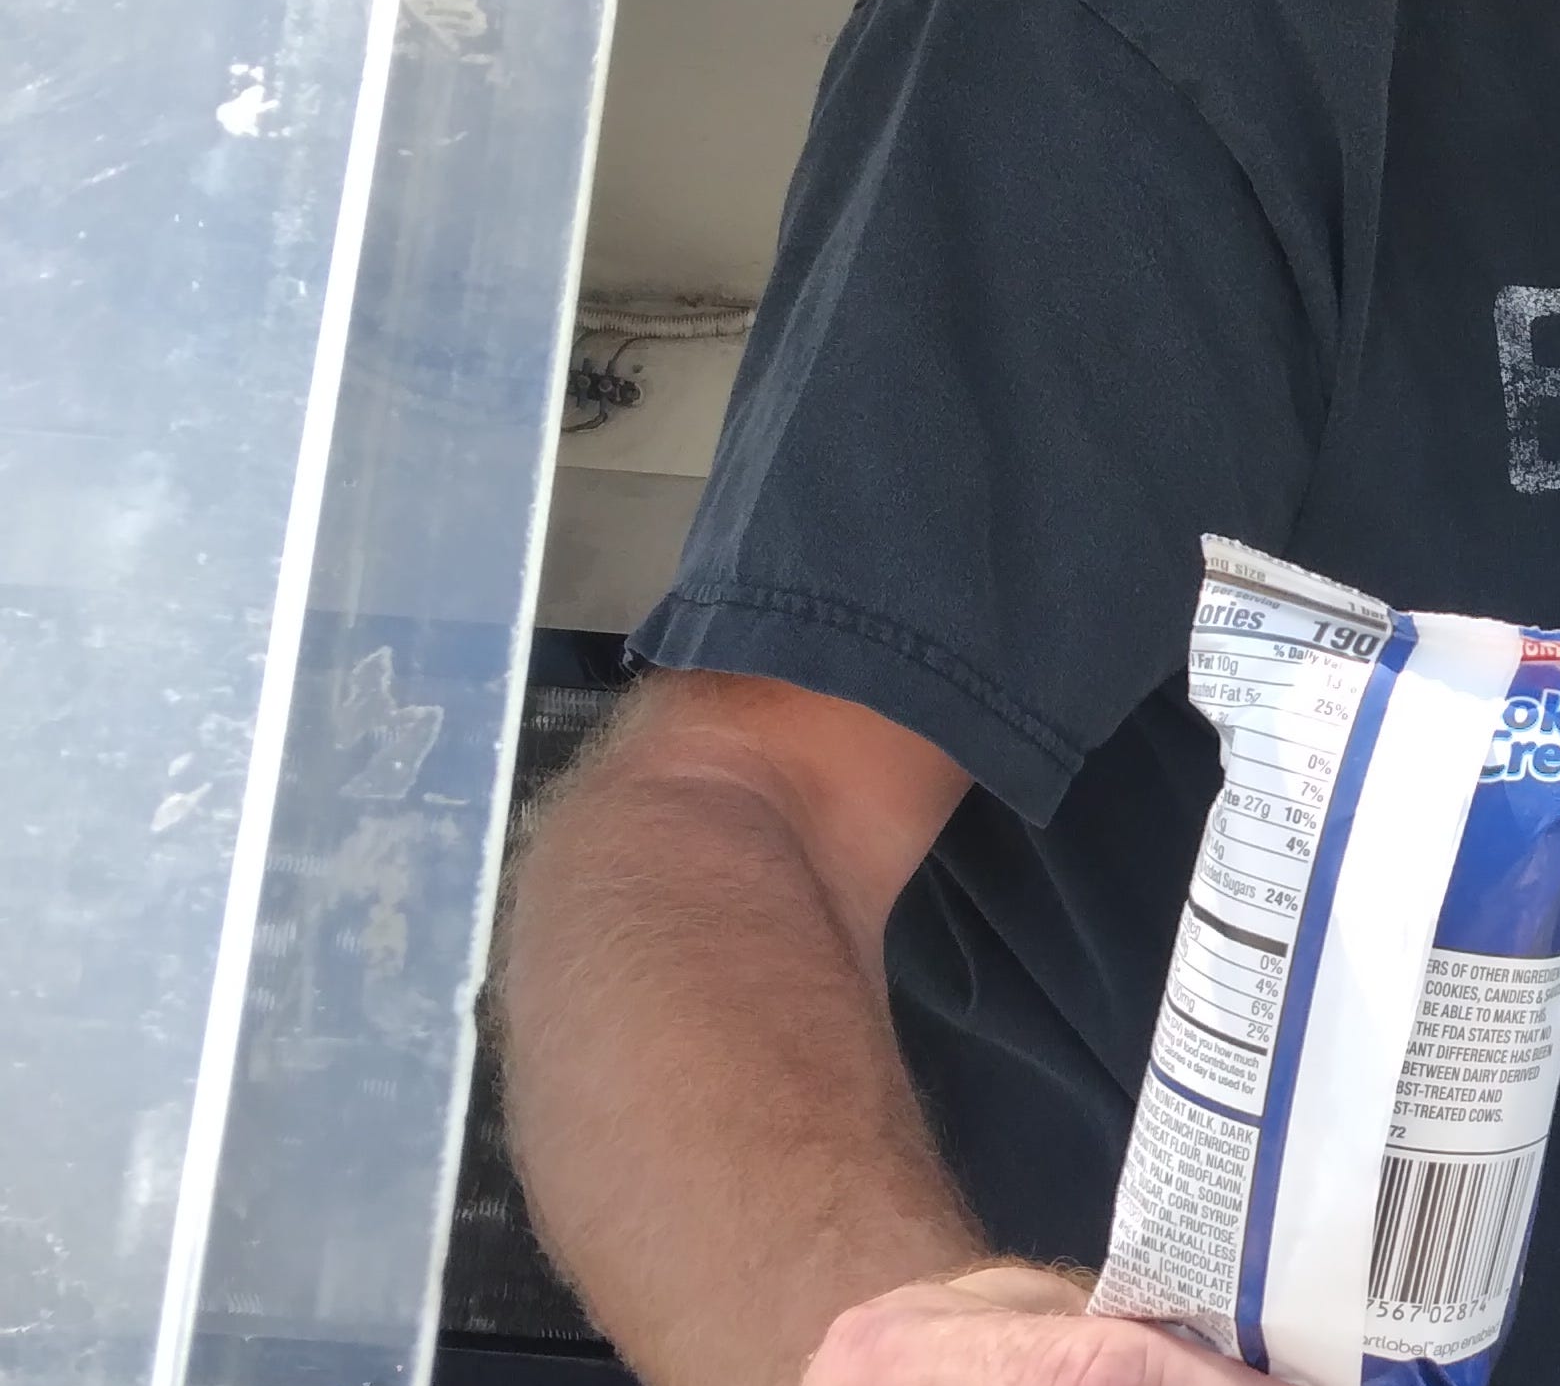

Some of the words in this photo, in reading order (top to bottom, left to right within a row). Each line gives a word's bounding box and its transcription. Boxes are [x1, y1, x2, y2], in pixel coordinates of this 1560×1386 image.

[1312, 619, 1381, 657] 190
[1197, 652, 1215, 670] Fat
[1216, 654, 1240, 676] 10g
[1288, 645, 1320, 664] Daily
[1219, 683, 1242, 703] Fat
[1313, 698, 1349, 721] 25%
[1307, 753, 1332, 775] 0%
[1300, 780, 1324, 803] 7%
[1243, 793, 1272, 819] 27g
[1283, 805, 1317, 830] 10%
[1285, 836, 1311, 857] 4%
[1221, 871, 1257, 899] Sugars
[1264, 887, 1299, 912] 24%
[1259, 954, 1284, 975] 0%
[1450, 962, 1469, 979] OF
[1469, 964, 1510, 983] OTHER
[1254, 977, 1279, 998] 4%
[1424, 979, 1481, 1004] COOKIES,
[1483, 987, 1535, 1005] CANDIES
[1250, 999, 1274, 1021] 6%
[1421, 1000, 1440, 1017] BE
[1439, 1003, 1474, 1022] ABLE
[1475, 1006, 1491, 1023] TO
[1491, 1008, 1528, 1024] MAKE
[1246, 1022, 1270, 1043] 2%
[1415, 1020, 1441, 1038] THE
[1440, 1024, 1466, 1041] FDA
[1468, 1027, 1512, 1044] STATES
[1512, 1029, 1541, 1044] THAT
[1232, 1053, 1260, 1069] much
[1435, 1044, 1509, 1065] DIFFERENCE
[1509, 1048, 1531, 1064] HAS
[1400, 1060, 1462, 1082] BETWEEN
[1462, 1067, 1499, 1083] DAIRY
[1499, 1065, 1541, 1084] DERIVED
[1477, 1088, 1503, 1103] AND
[1154, 1086, 1187, 1117] NONFAT
[1219, 1121, 1254, 1145] DARK
[1468, 1107, 1504, 1123] COWS.
[1205, 1153, 1247, 1181] NIACIN,
[1150, 1161, 1174, 1187] PALM
[1197, 1185, 1243, 1213] SODIUM
[1178, 1159, 1244, 1199] RIBOFLAVIN,
[1168, 1192, 1199, 1216] CORN
[1140, 1233, 1167, 1255] MILK
[1169, 1243, 1236, 1280] CHOCOLATE
[1164, 1227, 1206, 1255] ALKALI,
[1207, 1241, 1237, 1264] LESS
[1208, 1292, 1233, 1312] SOY
[1432, 1341, 1460, 1359] app
